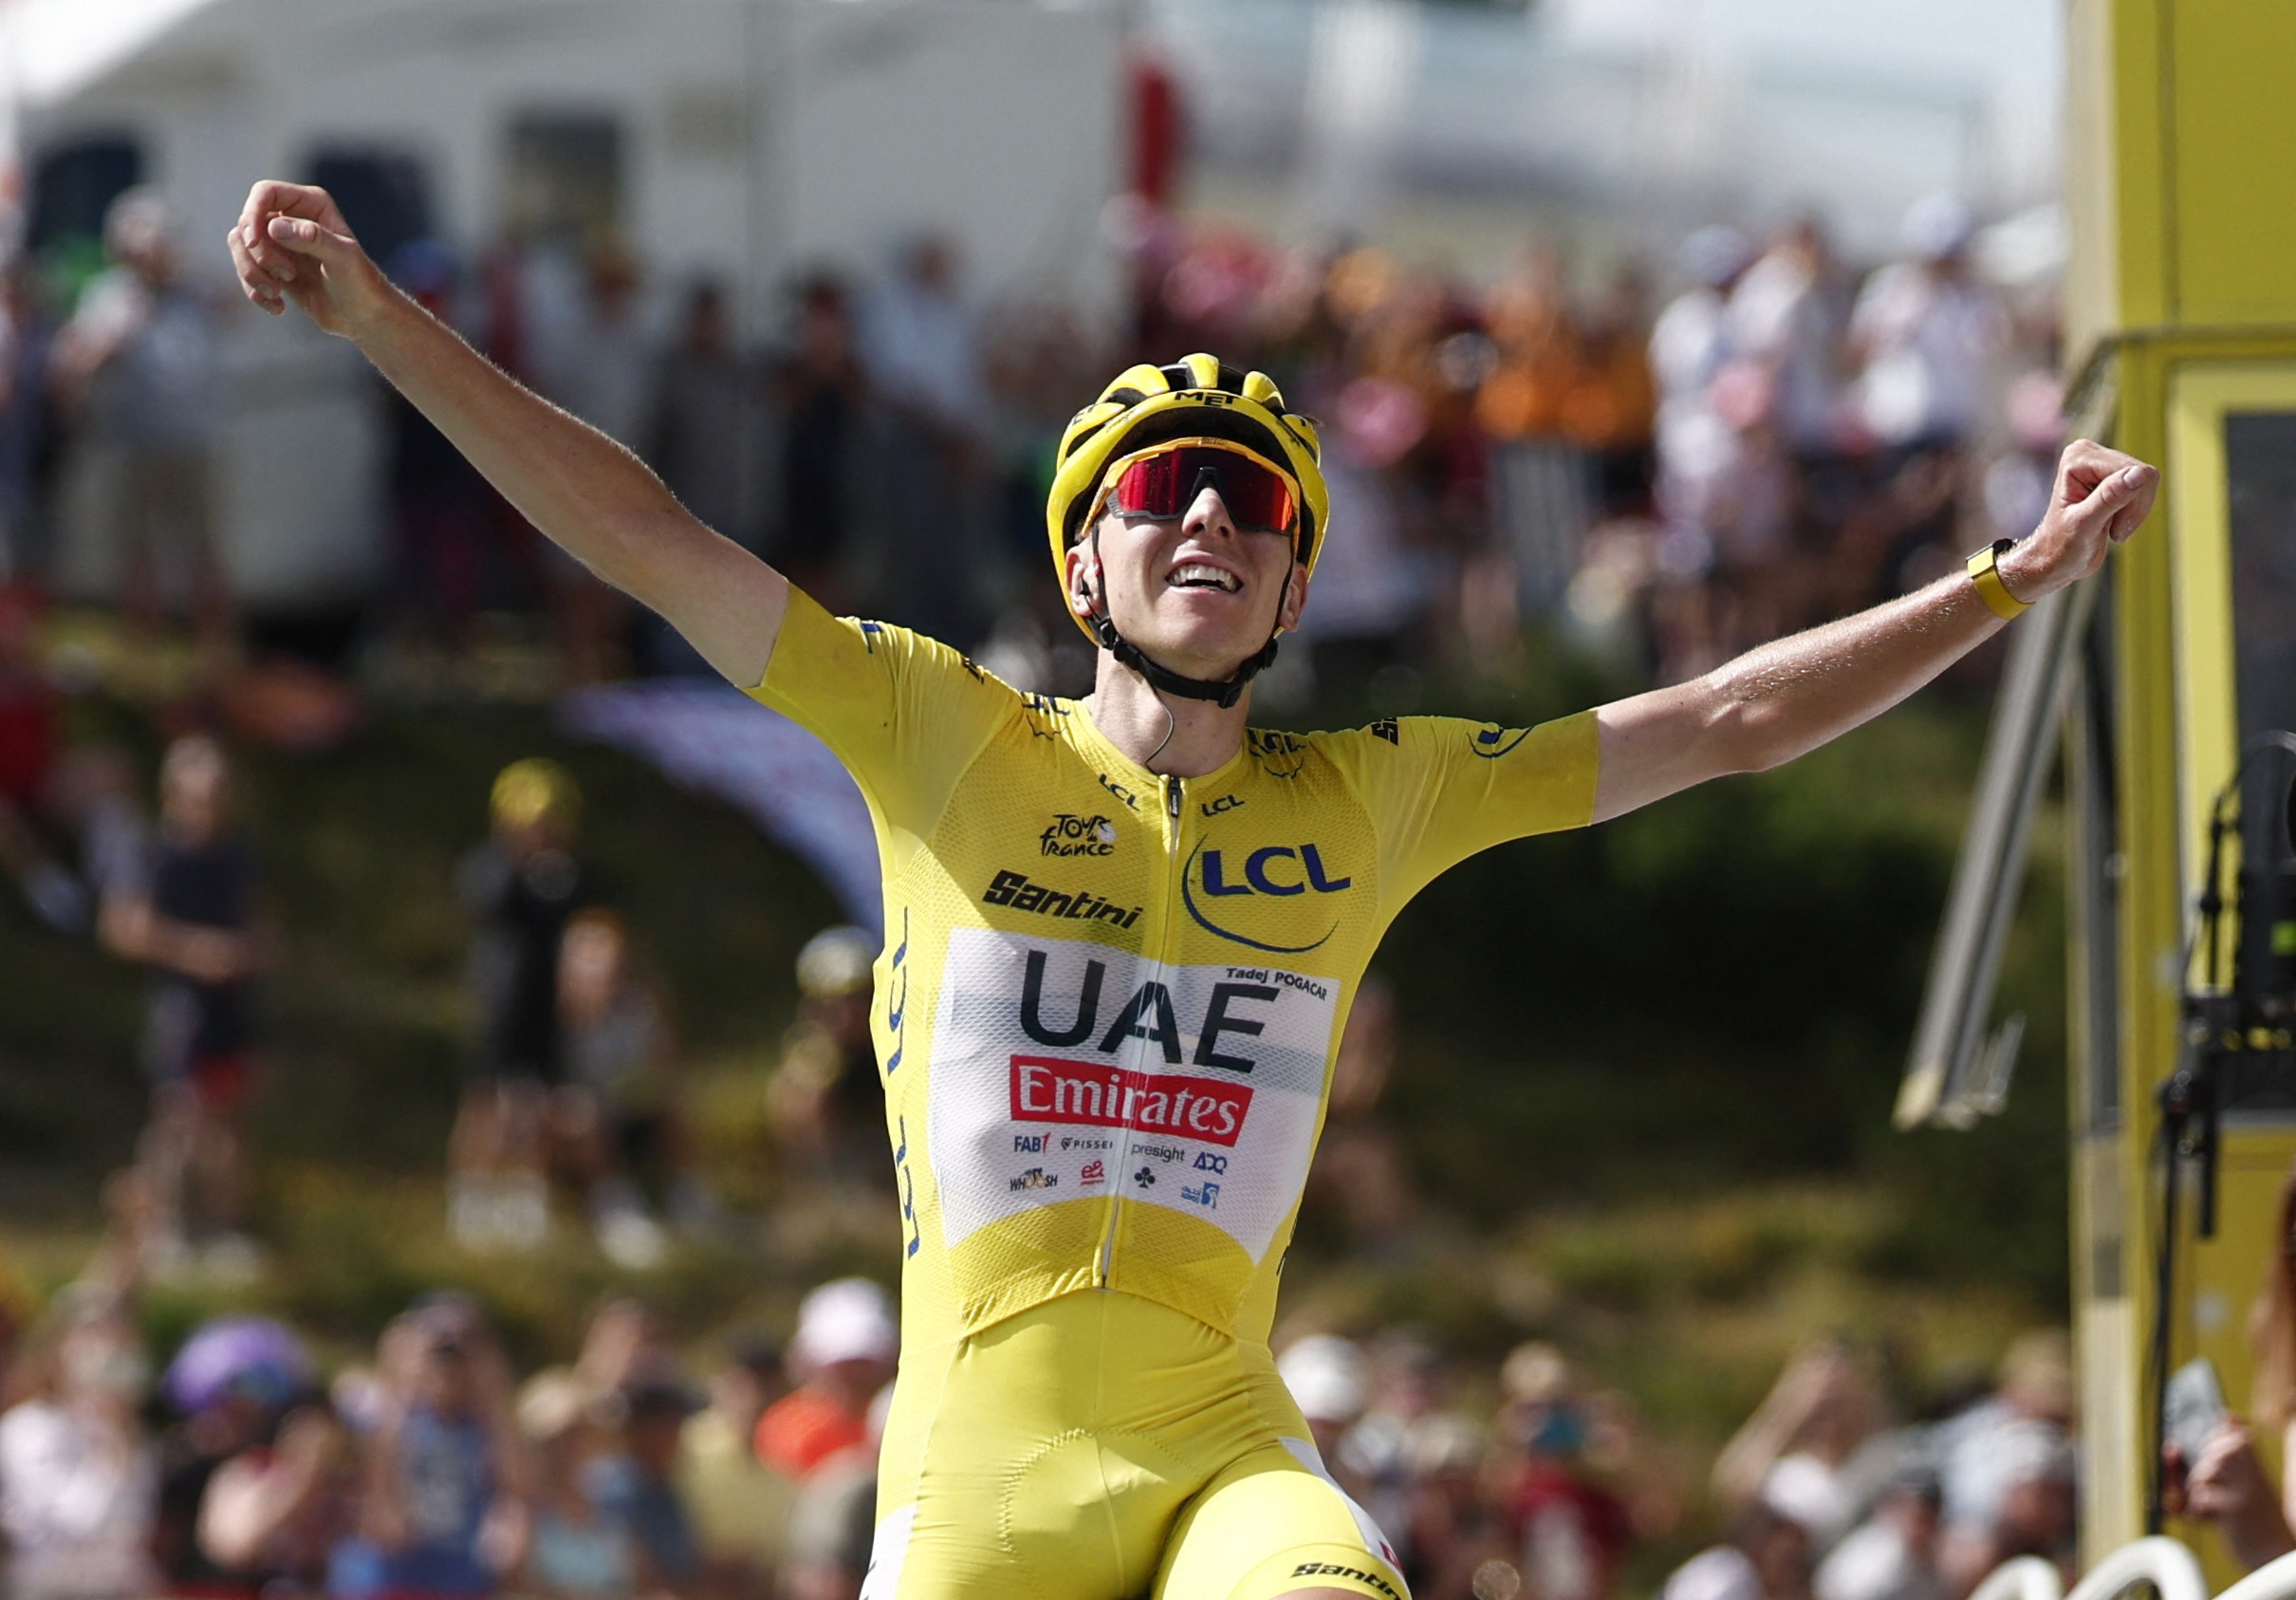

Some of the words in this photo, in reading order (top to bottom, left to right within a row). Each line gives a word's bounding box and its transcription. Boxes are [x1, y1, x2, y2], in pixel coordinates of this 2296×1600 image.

[1175, 392, 1240, 407] MET
[1099, 773, 1140, 811] LCL
[1201, 794, 1245, 817] LCL
[1202, 843, 1351, 896] LCL
[983, 869, 1143, 929] Santini
[887, 905, 908, 1077] LCL
[1226, 968, 1268, 984] Tadej
[1274, 972, 1327, 1001] POGACAR
[1020, 950, 1280, 1074] UAE
[1018, 1065, 1240, 1136] Emirates
[1073, 1140, 1114, 1149] PISSEI
[1131, 1144, 1185, 1163] presight
[1193, 1151, 1228, 1175] ADQ
[1289, 1562, 1401, 1600] Santin
